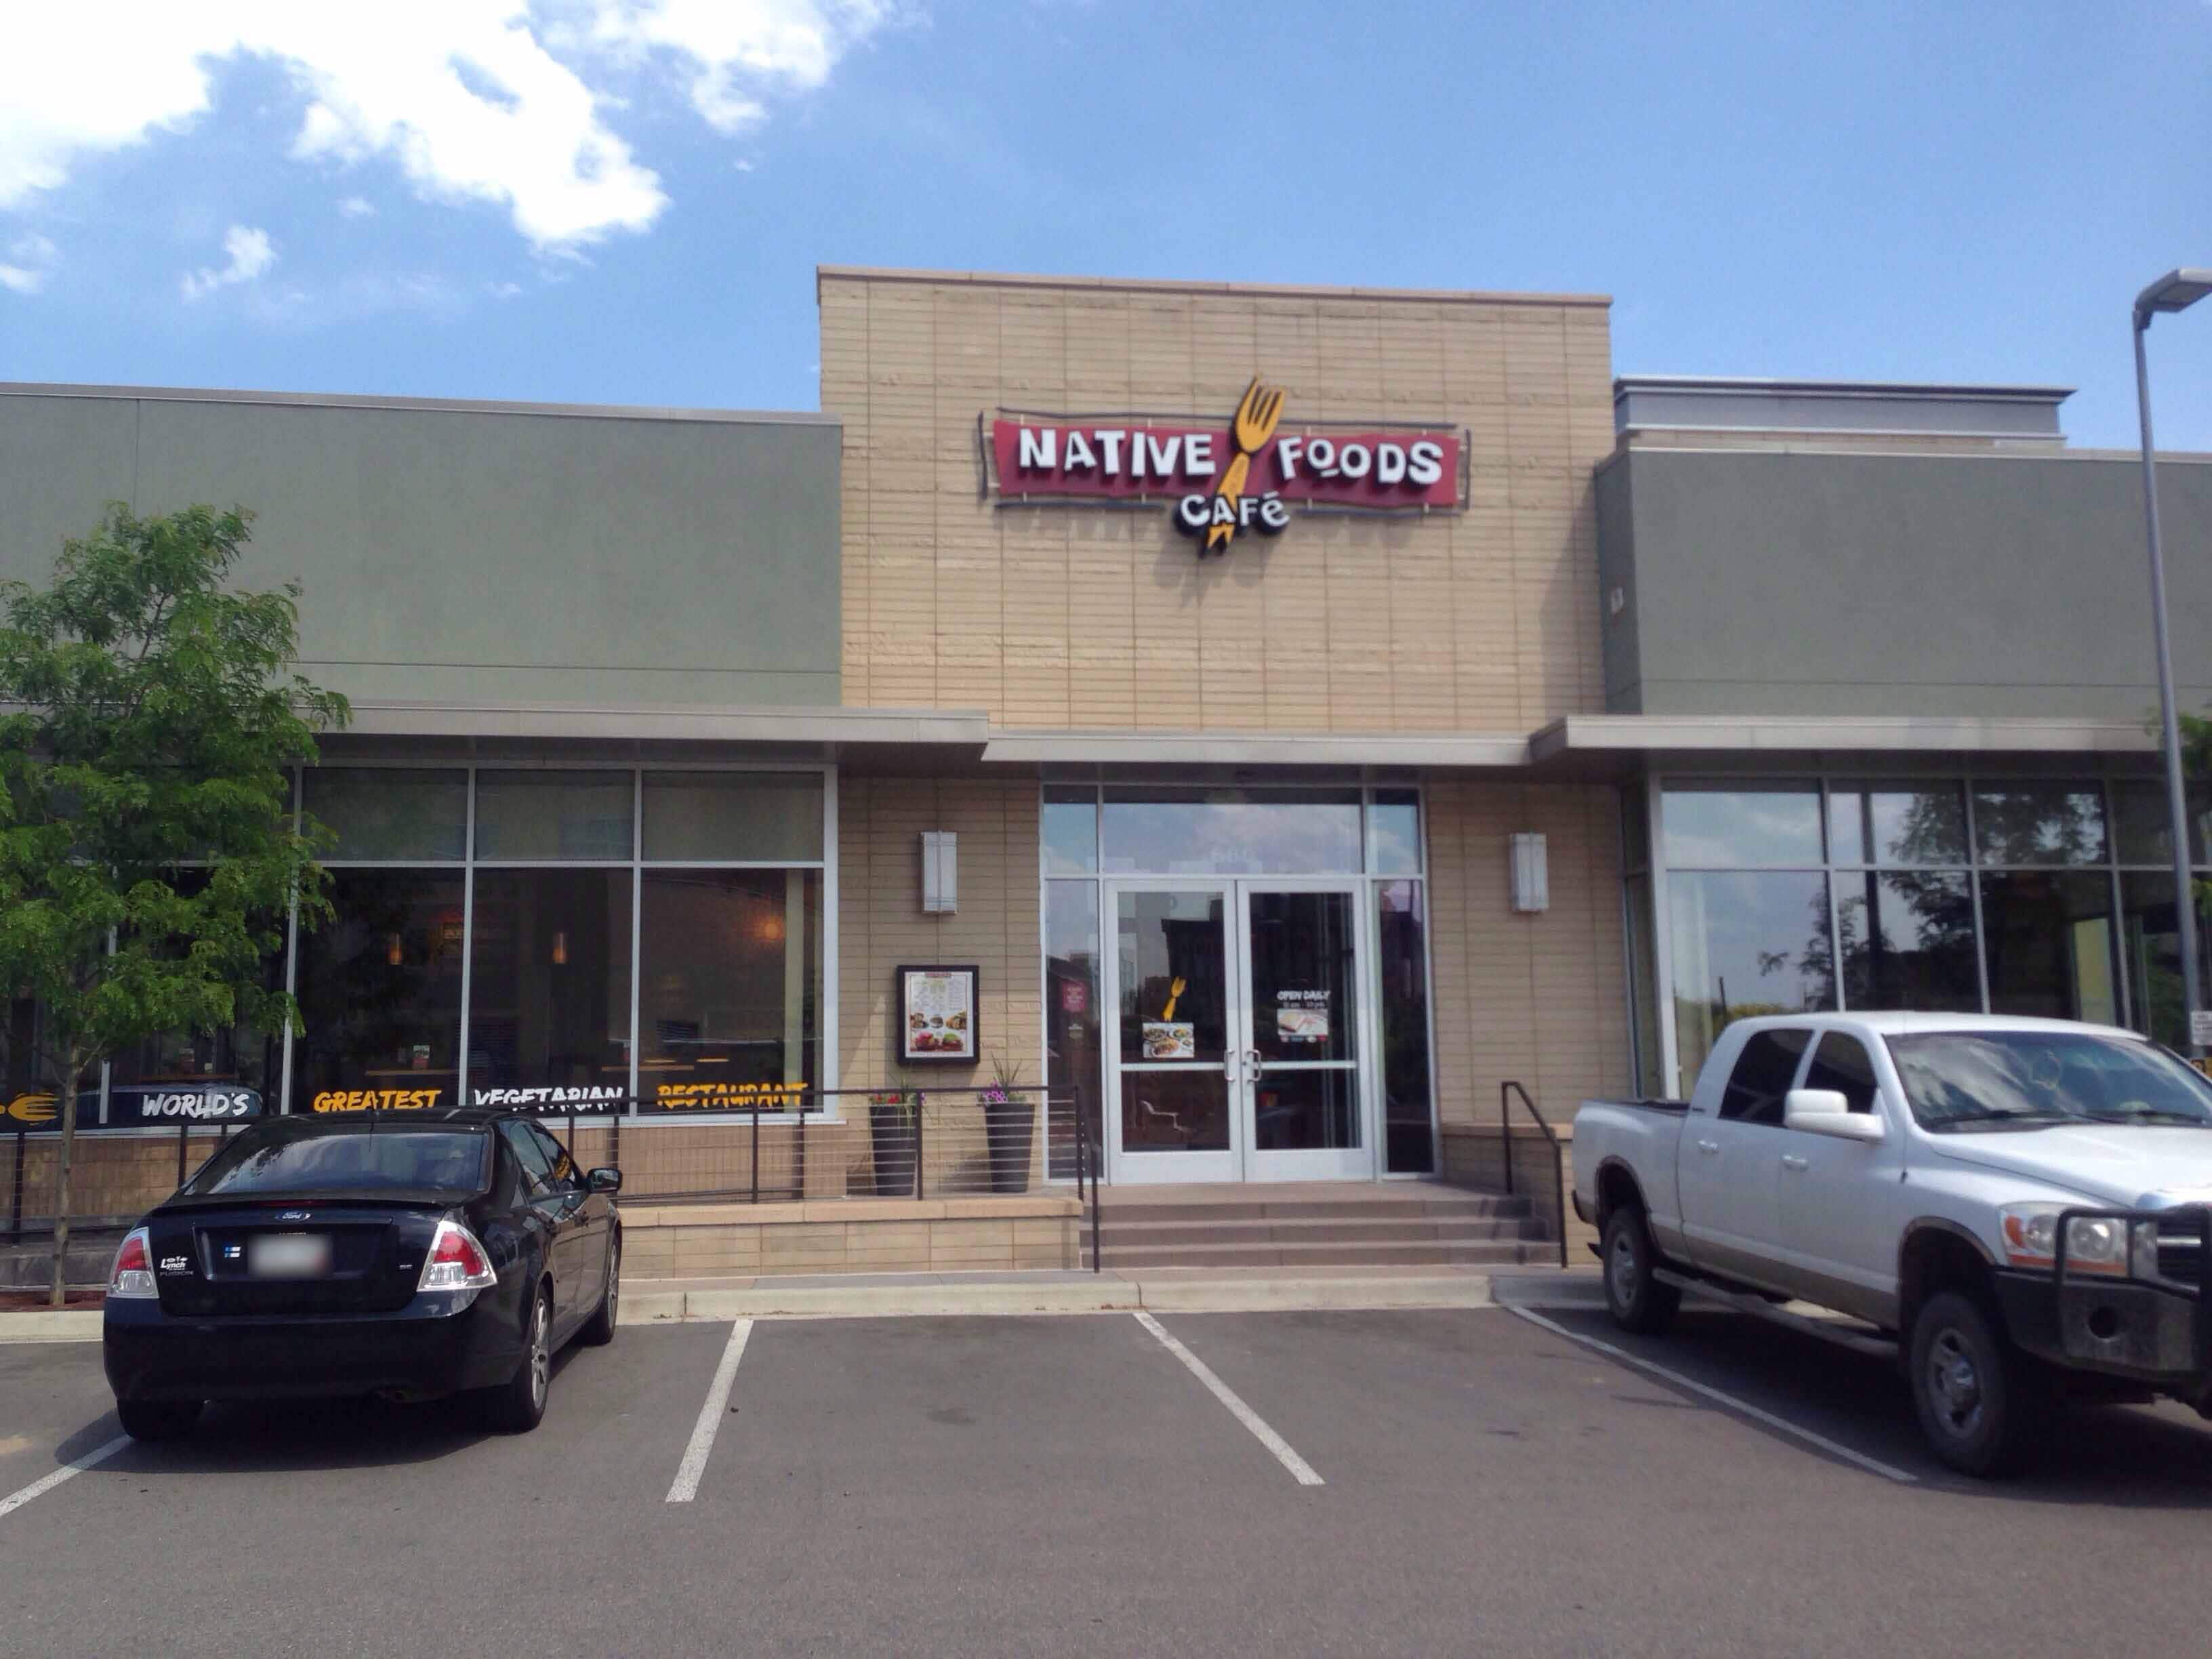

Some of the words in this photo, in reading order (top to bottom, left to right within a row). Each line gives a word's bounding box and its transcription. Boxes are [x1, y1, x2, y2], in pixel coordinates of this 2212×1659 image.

[1019, 428, 1216, 477] NATIVE
[1277, 436, 1444, 485] FOODS
[1277, 990, 1302, 1001] OPEN
[1303, 990, 1331, 1001] DAILY
[141, 1093, 250, 1119] WORLD'S
[314, 1090, 442, 1113] GREATEST
[474, 1086, 623, 1112] VEGETARIAN
[656, 1082, 808, 1109] RESTAURANT
[160, 1258, 186, 1270] Lynch
